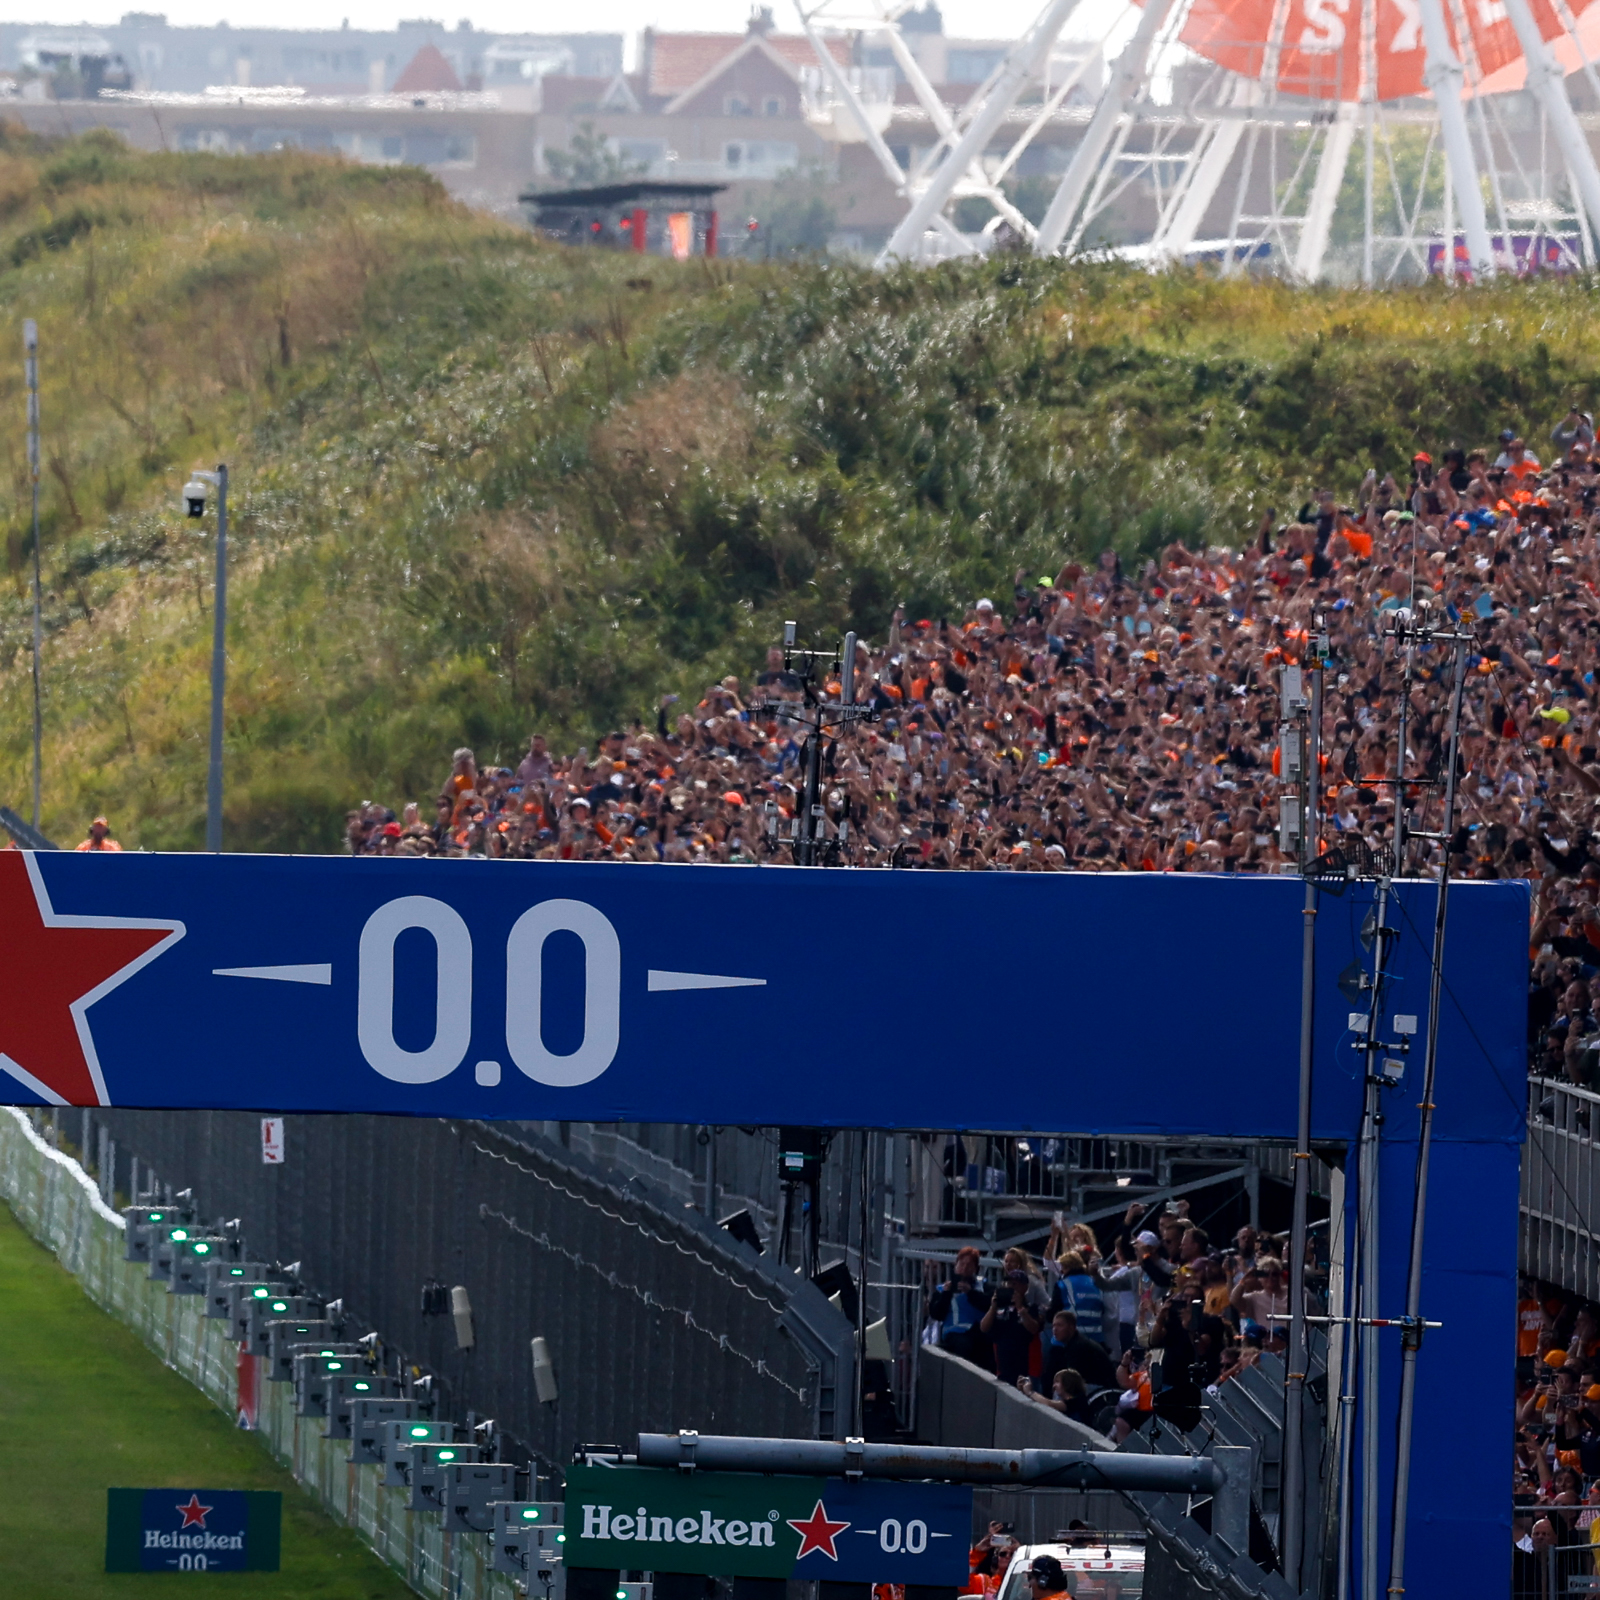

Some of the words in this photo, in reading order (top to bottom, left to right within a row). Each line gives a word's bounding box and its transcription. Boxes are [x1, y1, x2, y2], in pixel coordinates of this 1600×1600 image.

[357, 895, 621, 1088] 0.0
[144, 1530, 244, 1550] Heineken
[580, 1504, 776, 1547] Heineken
[880, 1518, 928, 1554] 0.0
